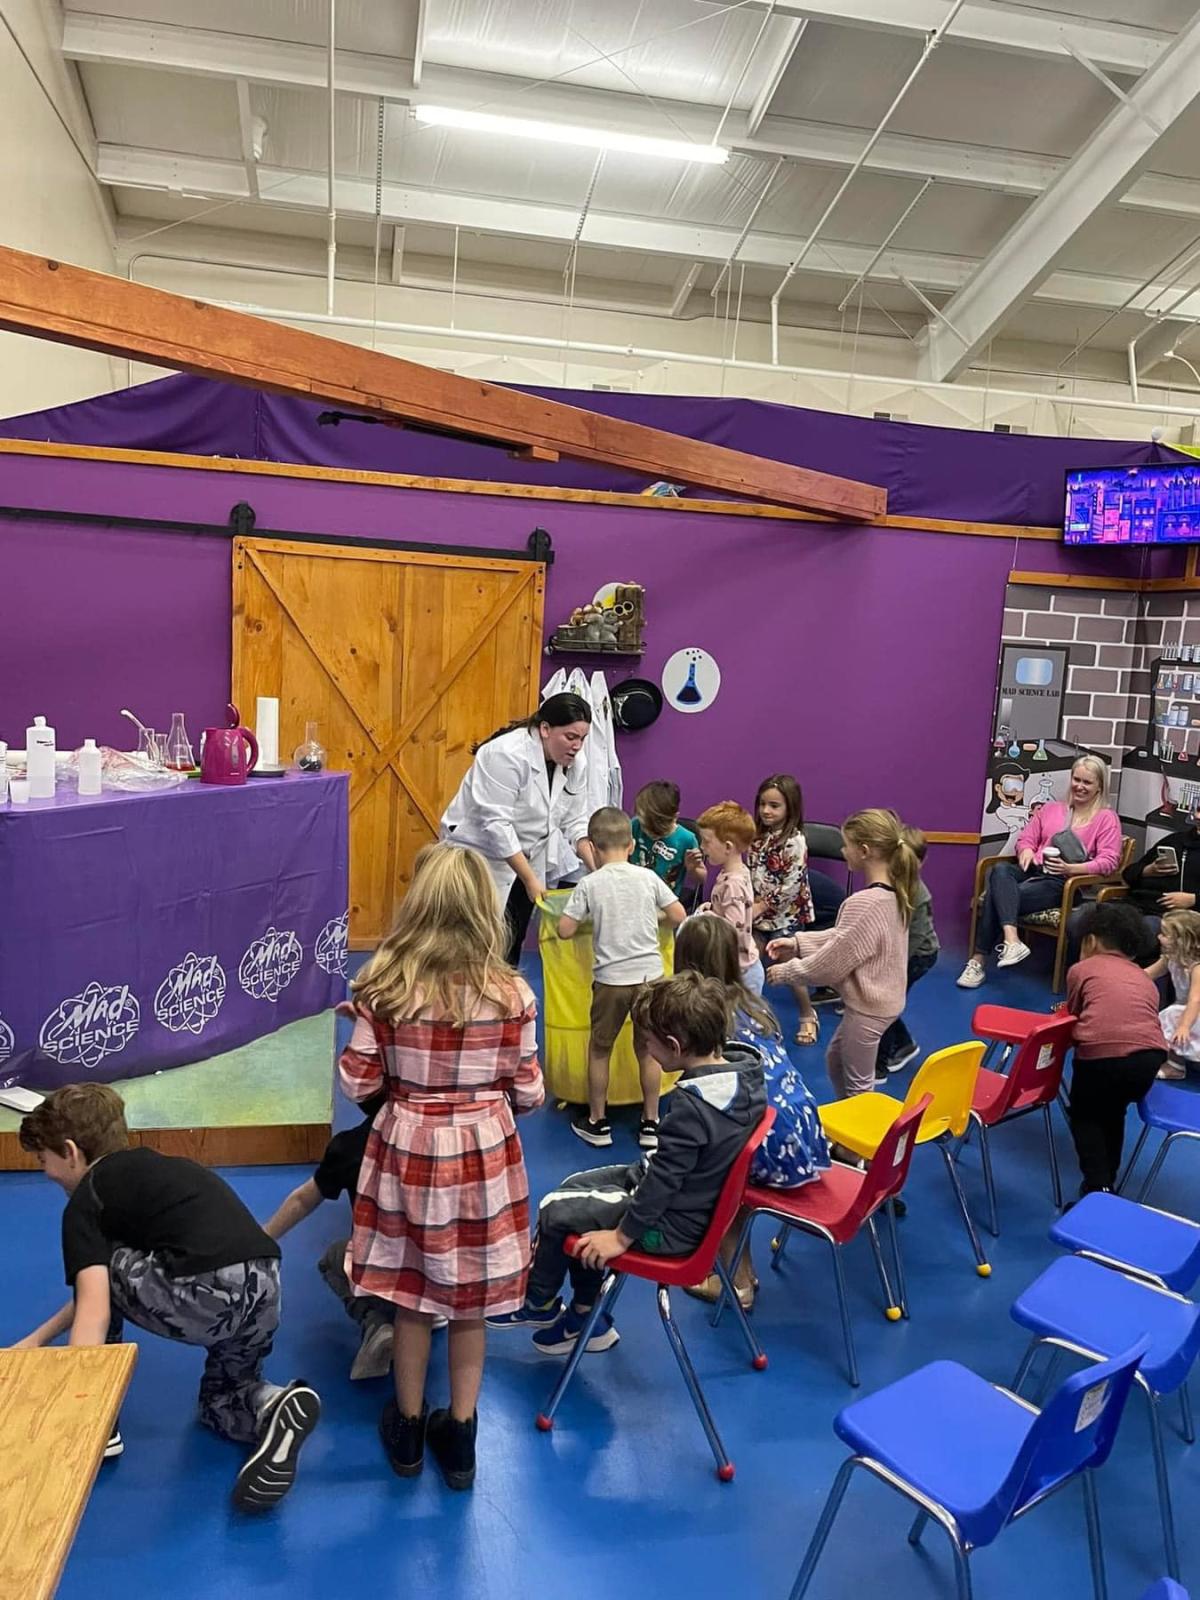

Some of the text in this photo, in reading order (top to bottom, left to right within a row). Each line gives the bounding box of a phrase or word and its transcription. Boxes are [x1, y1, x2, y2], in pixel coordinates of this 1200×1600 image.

[1002, 687, 1016, 695] MAD
[1018, 688, 1045, 697] SCIENCE
[316, 949, 348, 963] SCIE
[241, 960, 301, 989] SCIENCE
[157, 987, 226, 1021] SCIENCE
[42, 1020, 139, 1053] SCIENCE
